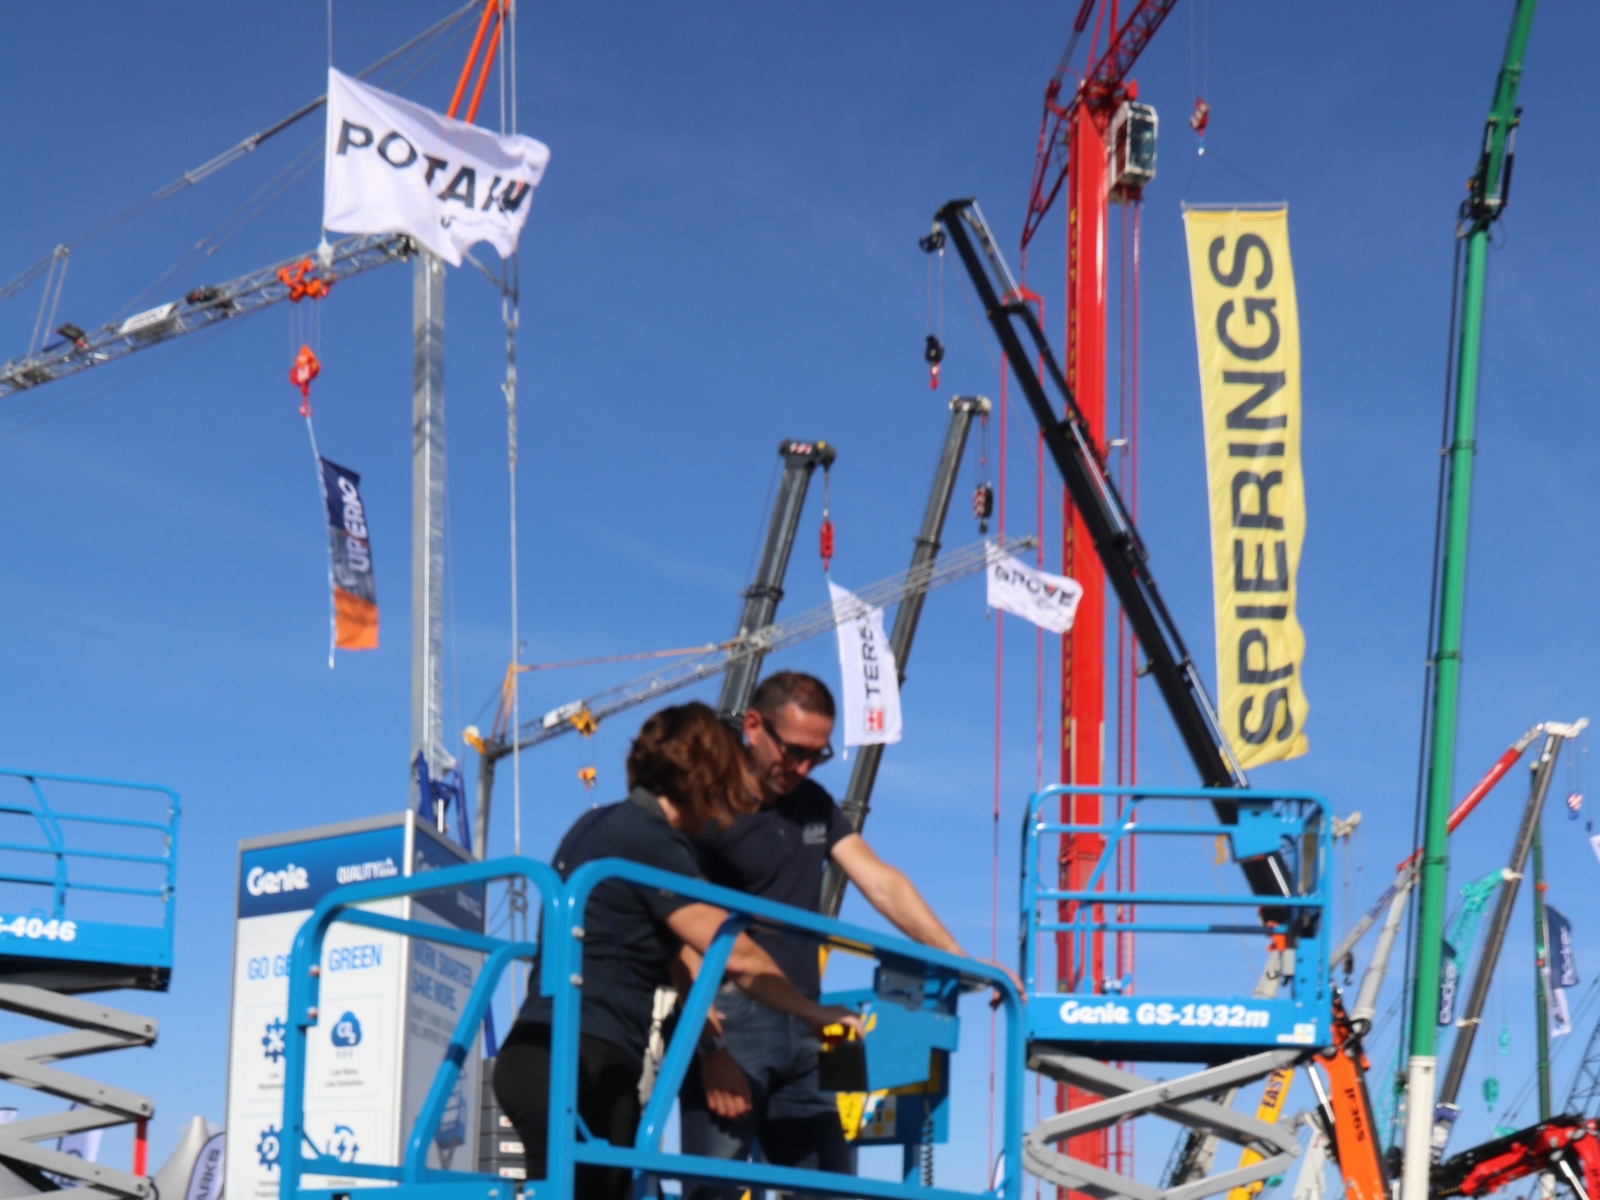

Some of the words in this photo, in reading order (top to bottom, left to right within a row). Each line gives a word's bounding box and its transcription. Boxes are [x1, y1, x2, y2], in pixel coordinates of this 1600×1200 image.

[1208, 233, 1294, 746] SPIERINGS
[247, 863, 309, 896] Genie
[0, 916, 77, 941] -4046
[248, 957, 269, 980] GO
[328, 944, 383, 972] GREEN
[1060, 1001, 1129, 1024] Genie
[1136, 1003, 1270, 1027] GS-1932m
